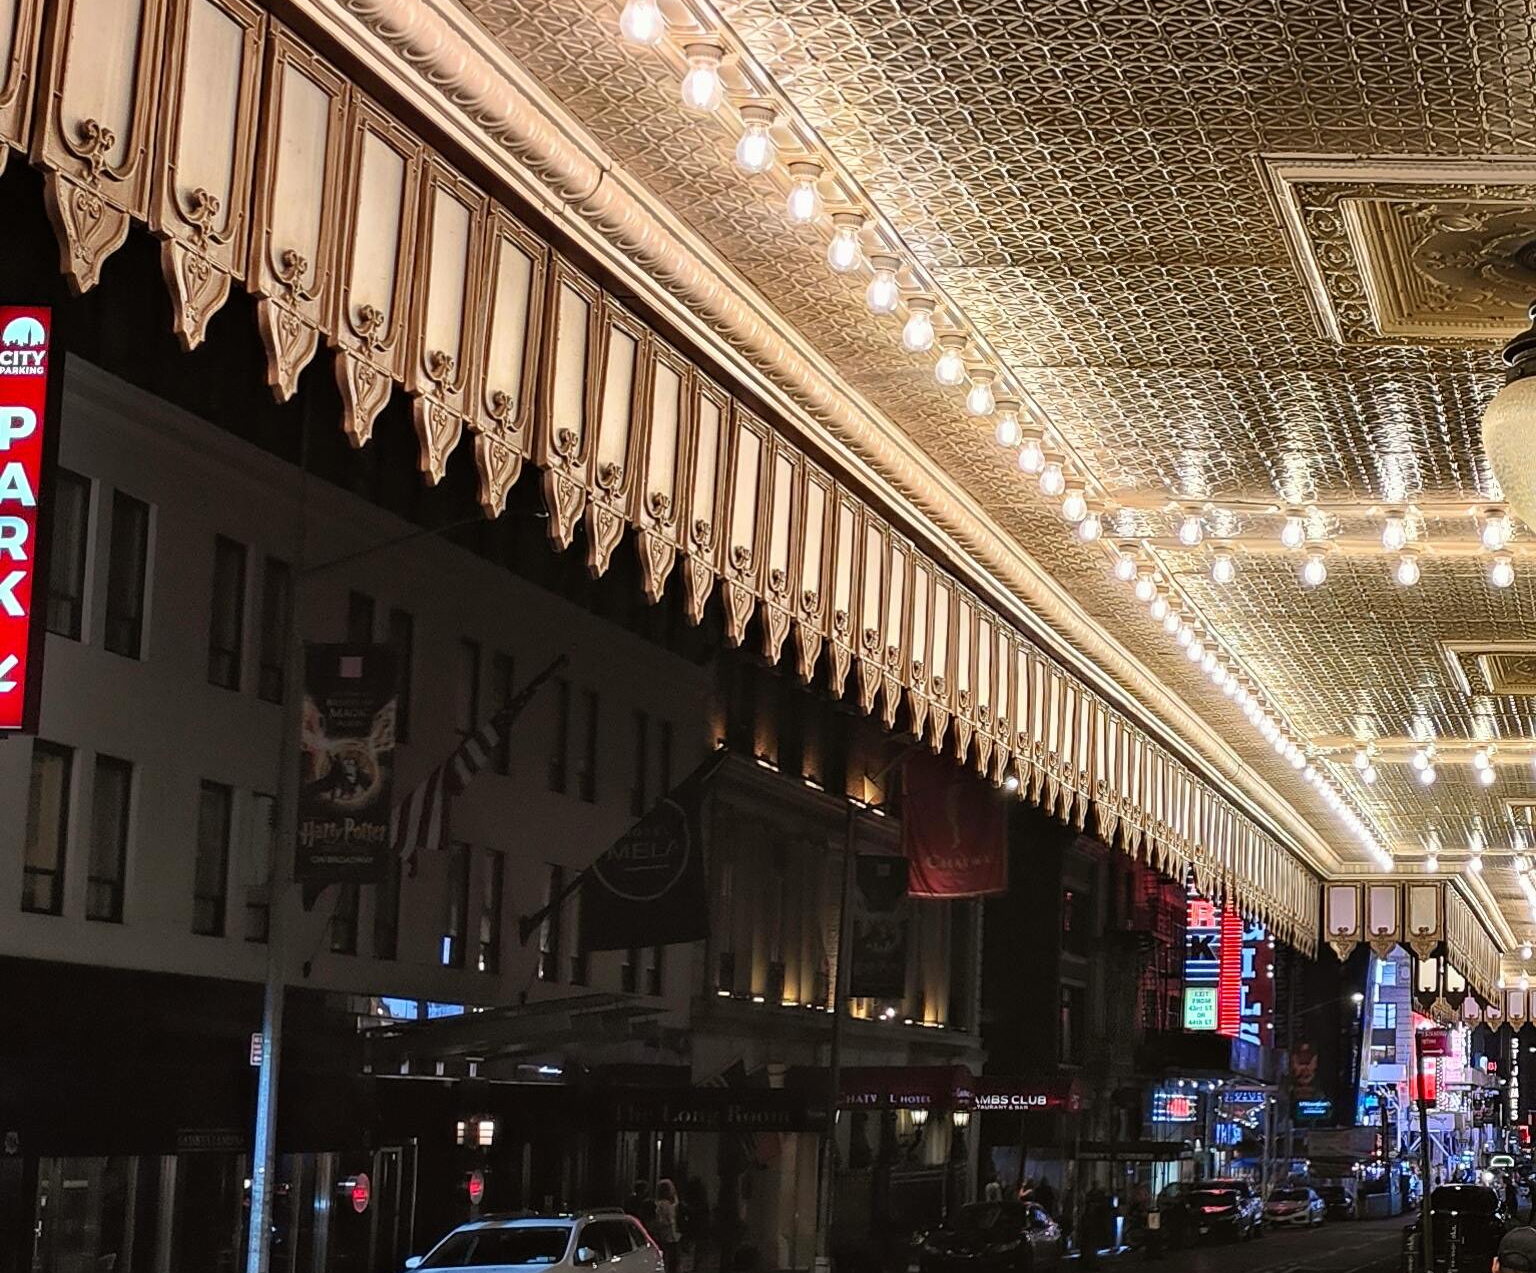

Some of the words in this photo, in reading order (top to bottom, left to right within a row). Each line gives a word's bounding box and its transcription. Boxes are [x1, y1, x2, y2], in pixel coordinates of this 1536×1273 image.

[0, 350, 46, 366] CITY
[0, 366, 44, 375] PARKING
[0, 406, 37, 617] PARK
[1011, 1095, 1047, 1105] CLUB
